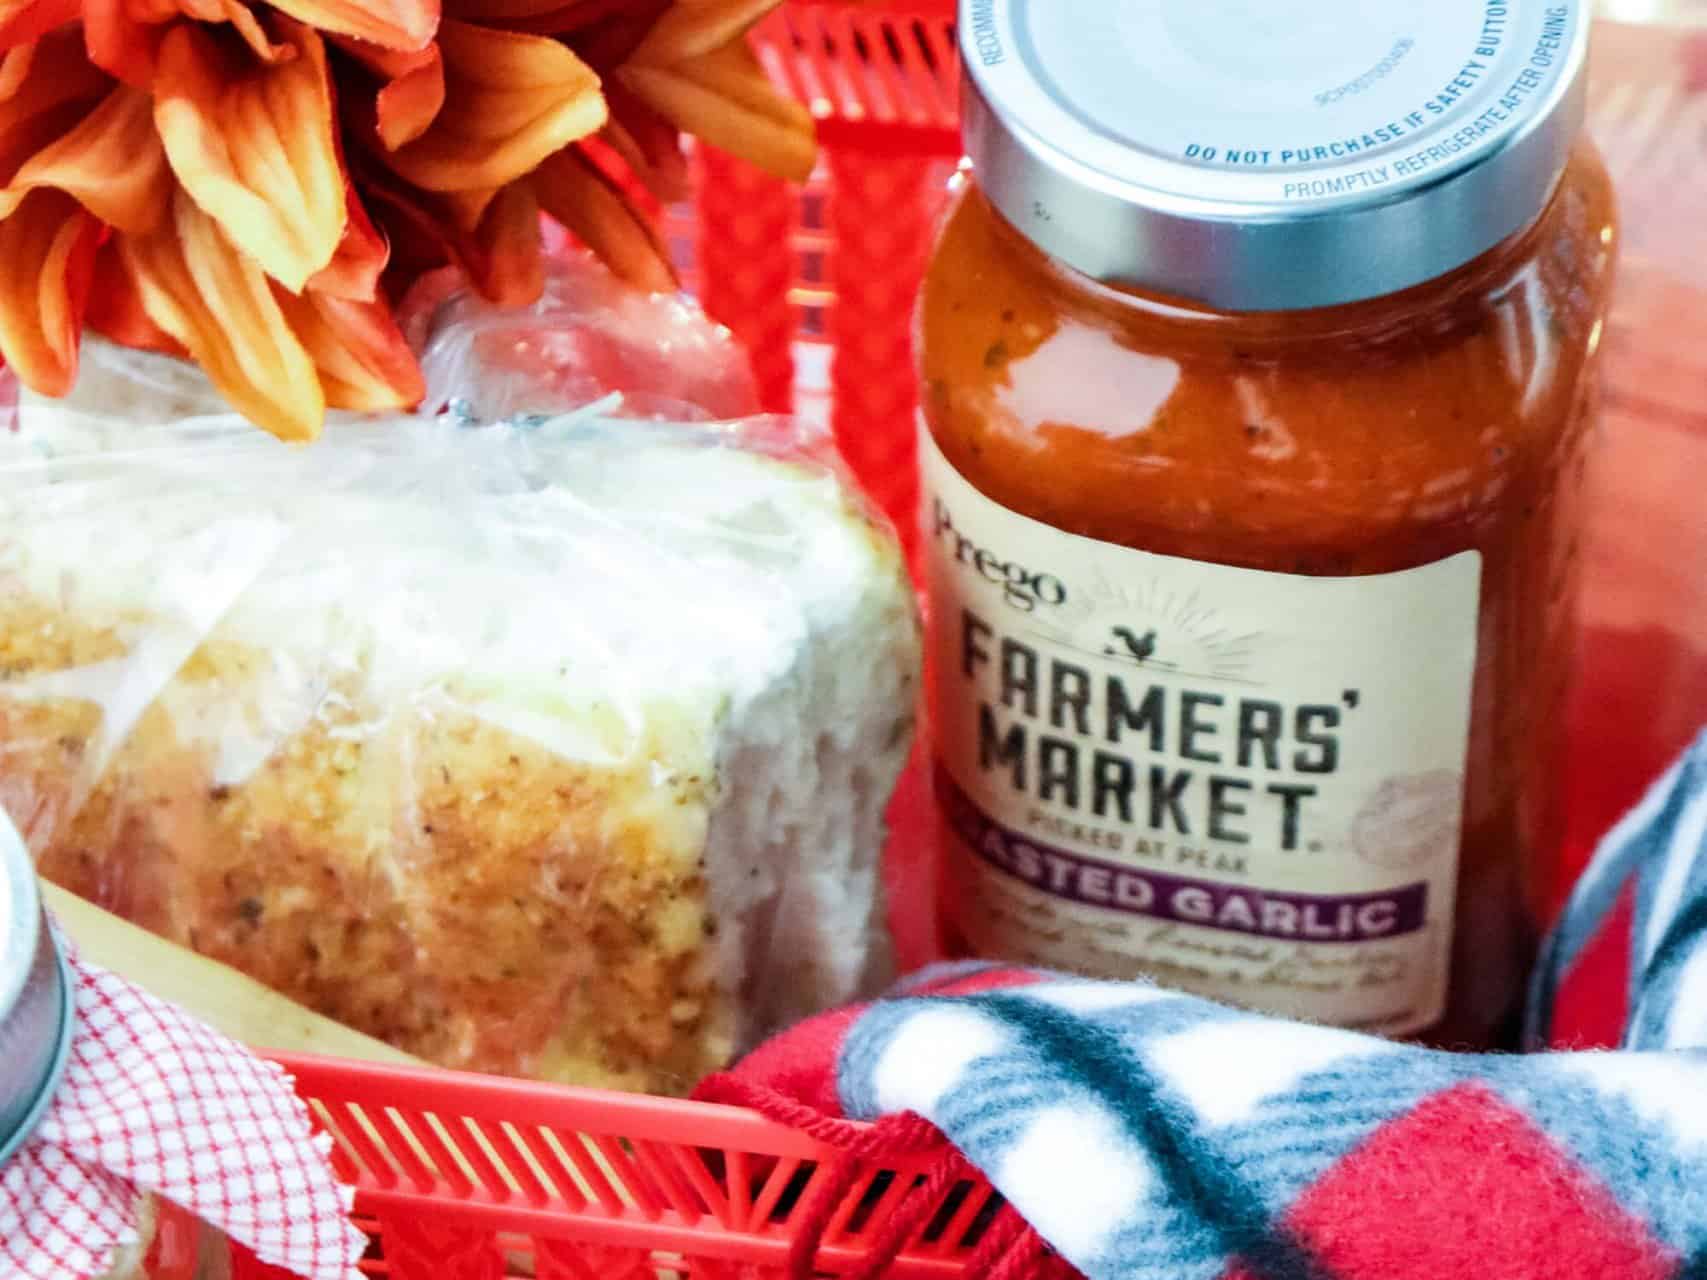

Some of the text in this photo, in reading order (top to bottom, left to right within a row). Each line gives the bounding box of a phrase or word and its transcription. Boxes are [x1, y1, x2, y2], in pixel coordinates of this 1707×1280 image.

[1185, 142, 1217, 162] DO
[1225, 149, 1273, 165] NOT
[1280, 122, 1405, 164] PURCHASE
[1403, 110, 1425, 129] IF
[1424, 60, 1487, 115] SAFETY
[1283, 5, 1569, 199] PROMPTLY REFRIGERATE AFTER OPENING.
[933, 494, 1067, 612] Prego
[982, 827, 1156, 909] ASTED
[1169, 886, 1399, 936] GARLIC
[1134, 838, 1166, 857] AT
[1176, 846, 1249, 873] PEAK
